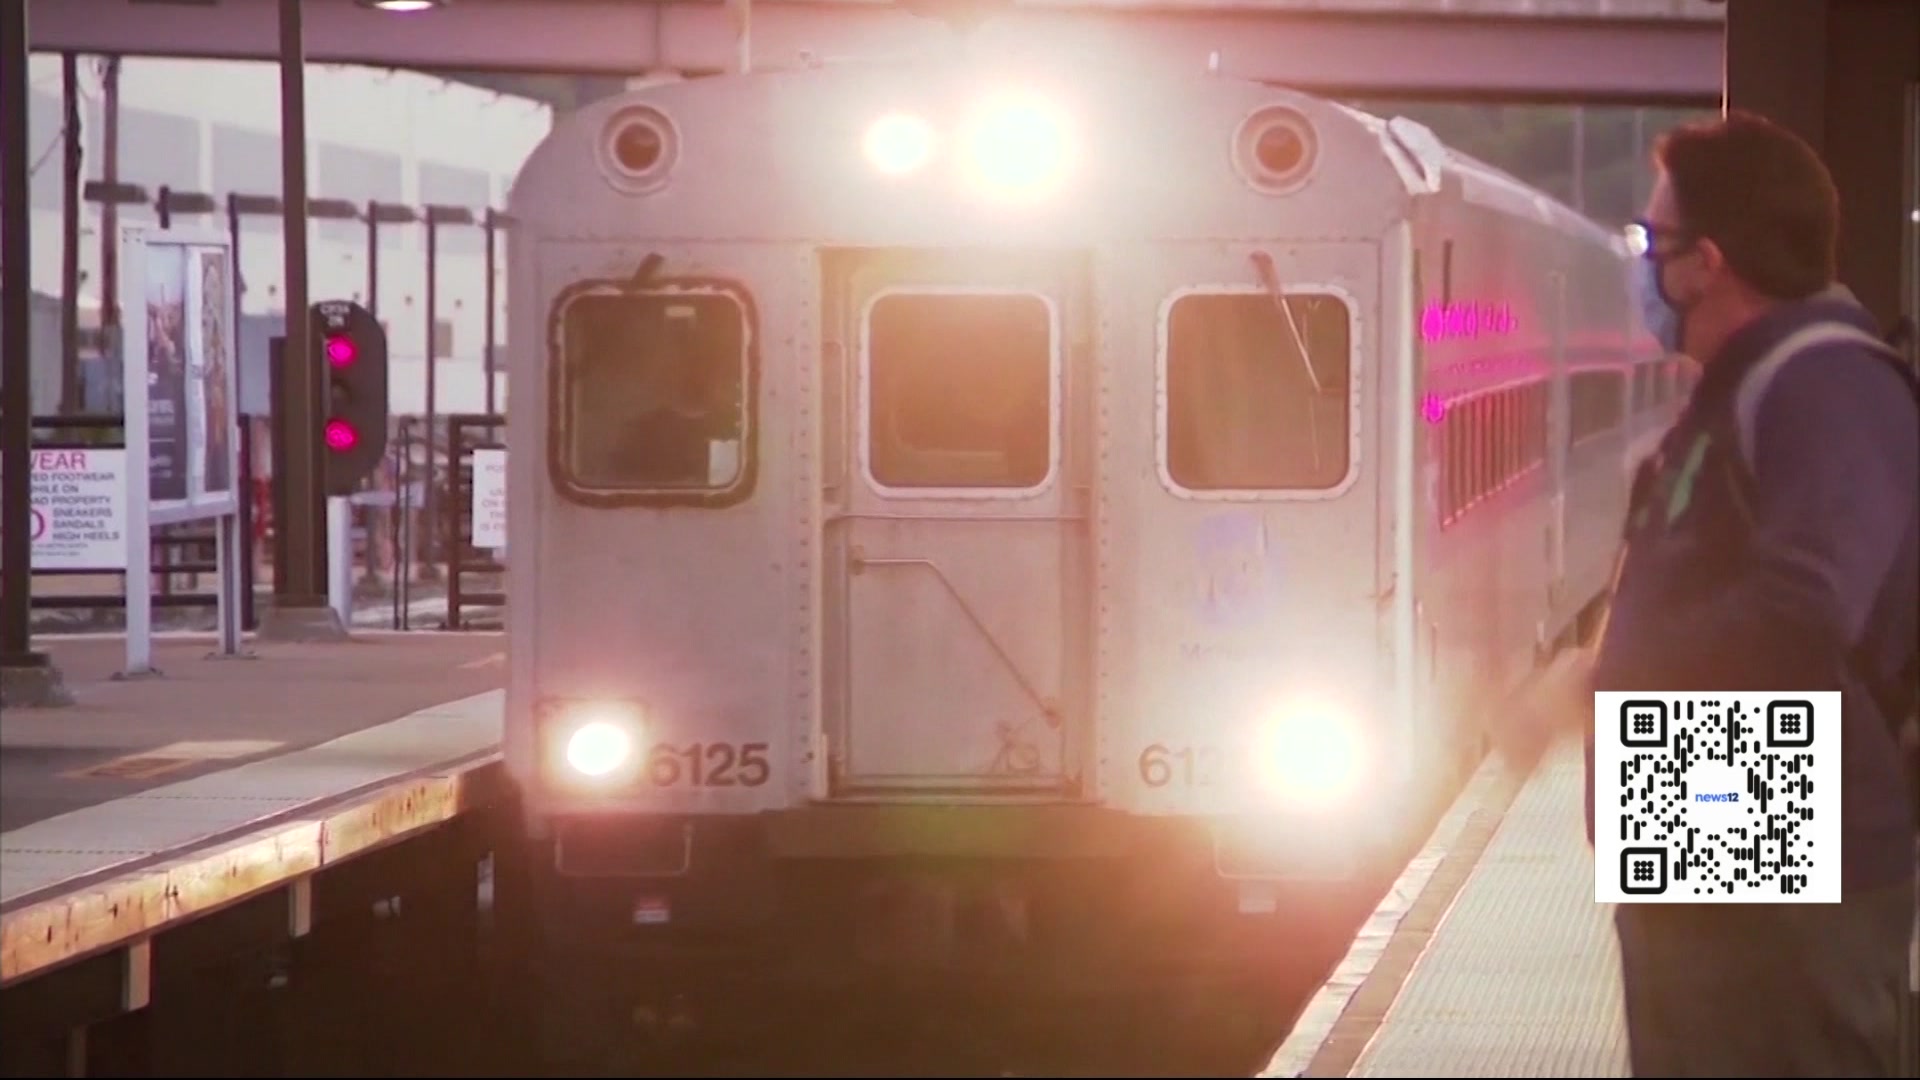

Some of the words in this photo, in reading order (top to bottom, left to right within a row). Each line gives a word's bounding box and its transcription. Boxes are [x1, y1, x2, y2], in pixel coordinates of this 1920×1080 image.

[51, 471, 115, 481] FOOTWEAR
[62, 484, 79, 493] ON
[51, 496, 111, 505] PROPERTY
[53, 507, 113, 518] SNEAKERS
[53, 519, 104, 529] SANDALS
[52, 531, 81, 540] HIGH
[83, 530, 120, 541] HEELS
[650, 742, 770, 787] 6125
